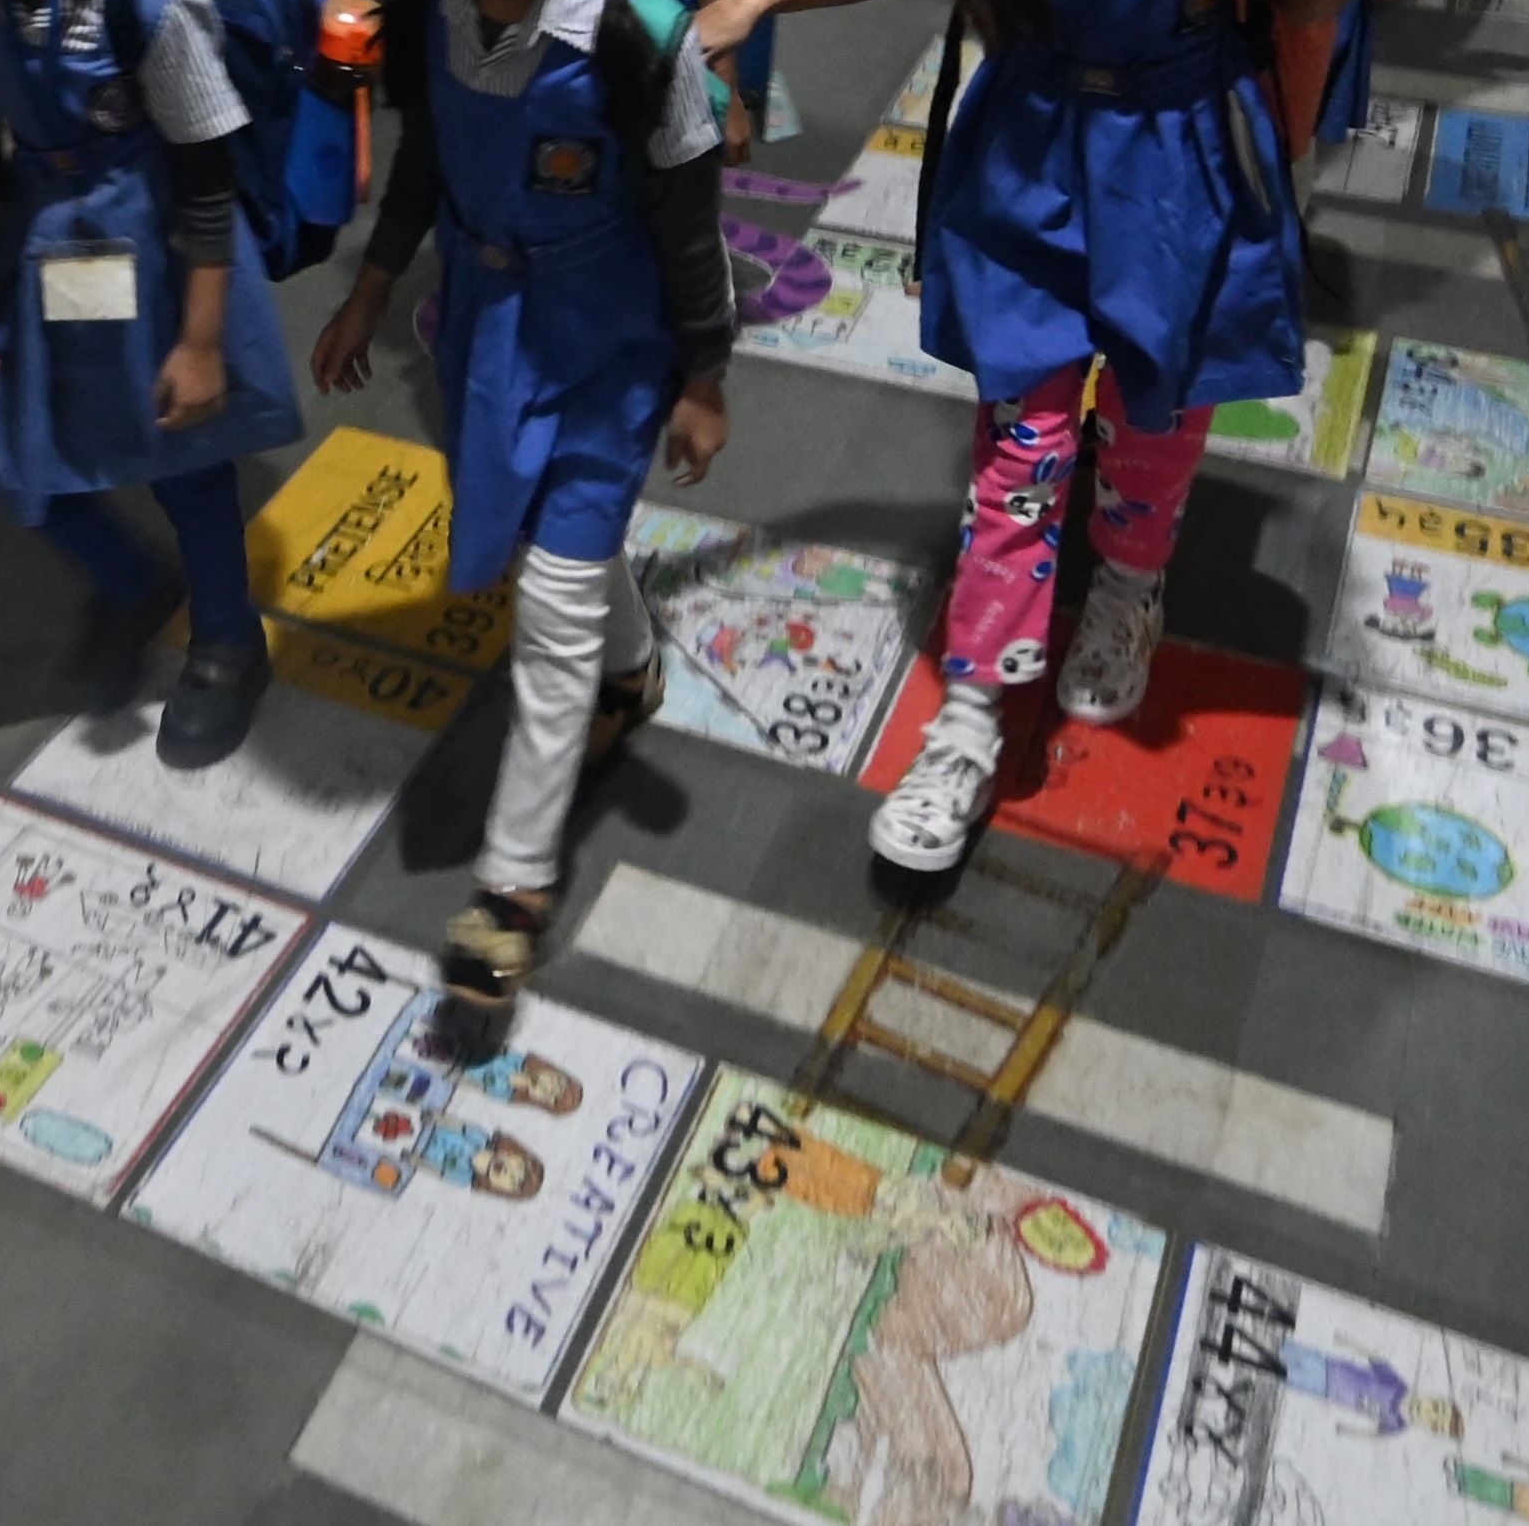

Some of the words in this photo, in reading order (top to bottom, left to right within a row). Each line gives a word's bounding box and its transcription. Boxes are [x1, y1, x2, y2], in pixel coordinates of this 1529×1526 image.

[426, 601, 496, 658] 39
[368, 663, 450, 712] 40
[772, 686, 845, 757] 38
[1420, 713, 1520, 772] 36
[1168, 795, 1244, 869] 37
[195, 895, 278, 959] 41
[303, 943, 390, 1019] 42
[711, 1103, 802, 1190] 43
[504, 1056, 671, 1349] CREATIVE
[1200, 1275, 1297, 1381] 44
